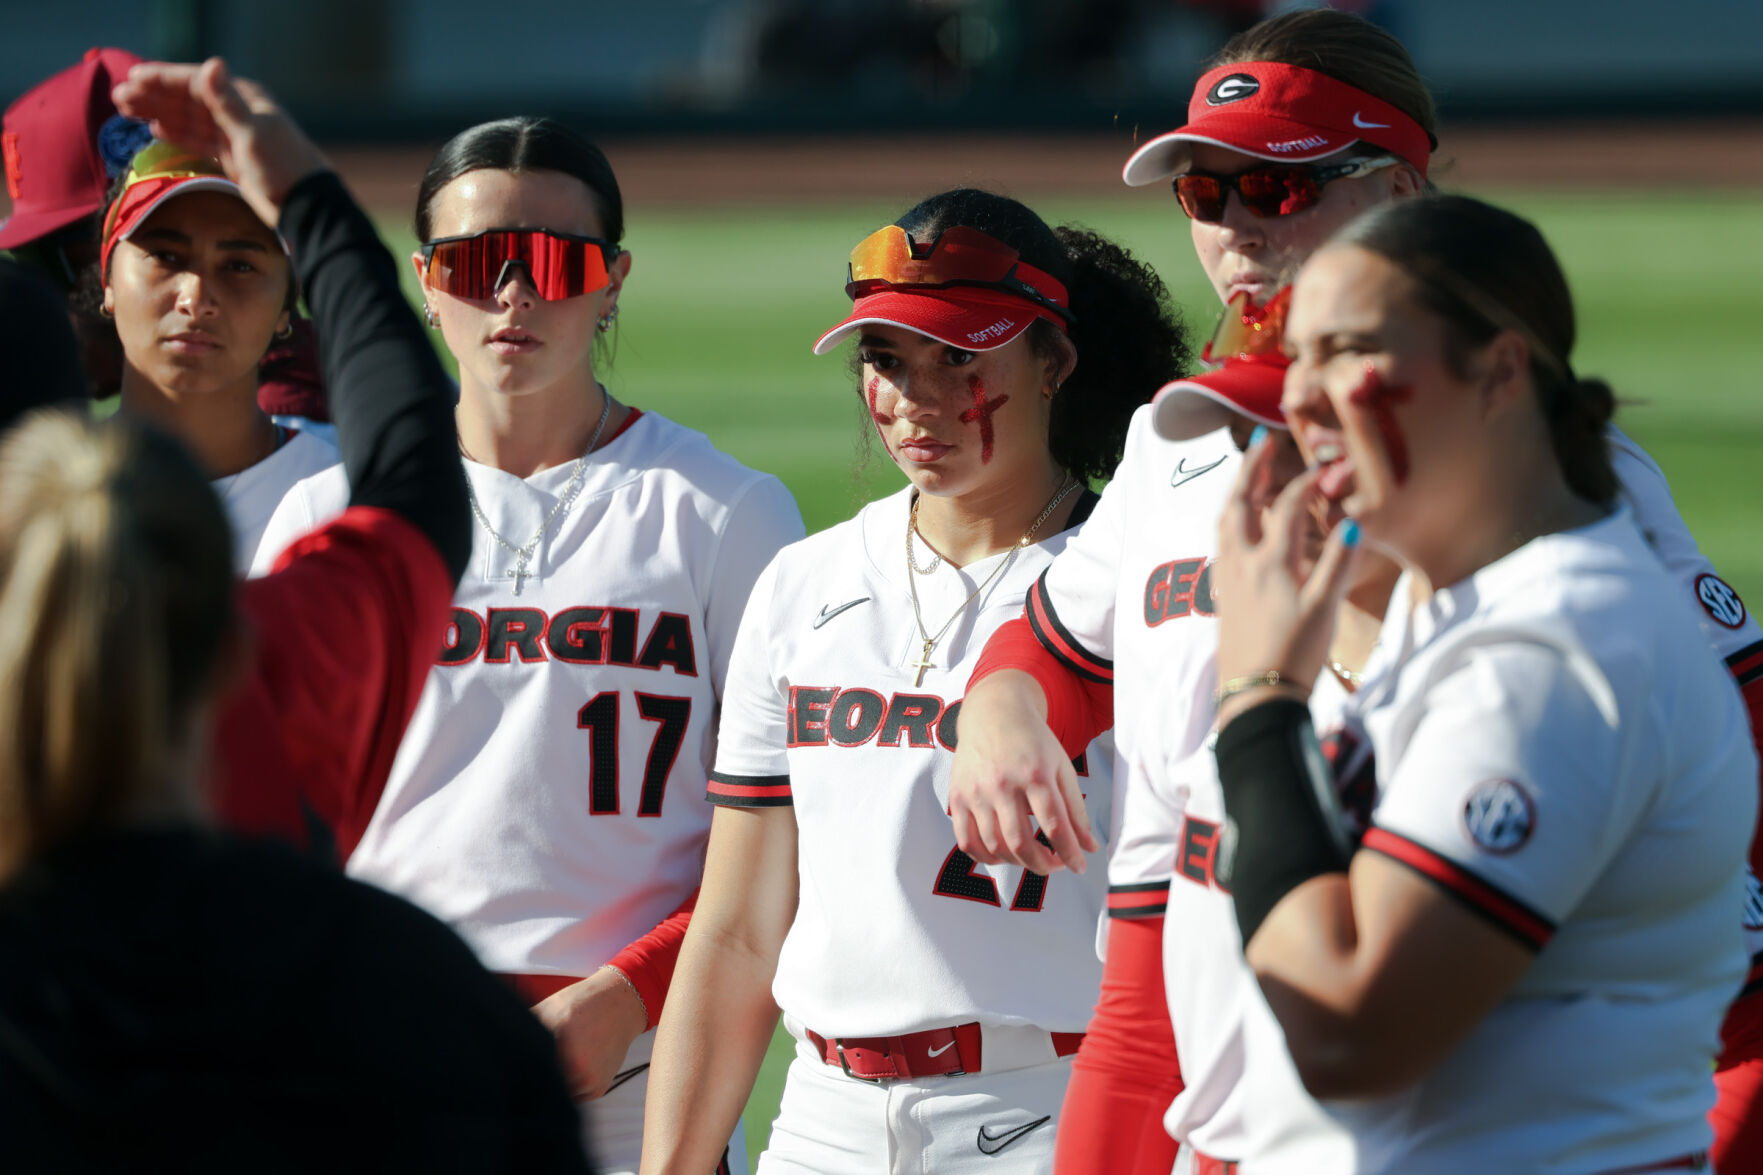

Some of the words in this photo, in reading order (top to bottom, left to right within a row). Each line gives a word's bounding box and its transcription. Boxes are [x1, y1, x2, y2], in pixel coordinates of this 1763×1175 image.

[967, 317, 1015, 343] SOFTBALL
[787, 685, 963, 753] EOR
[577, 690, 692, 817] 17
